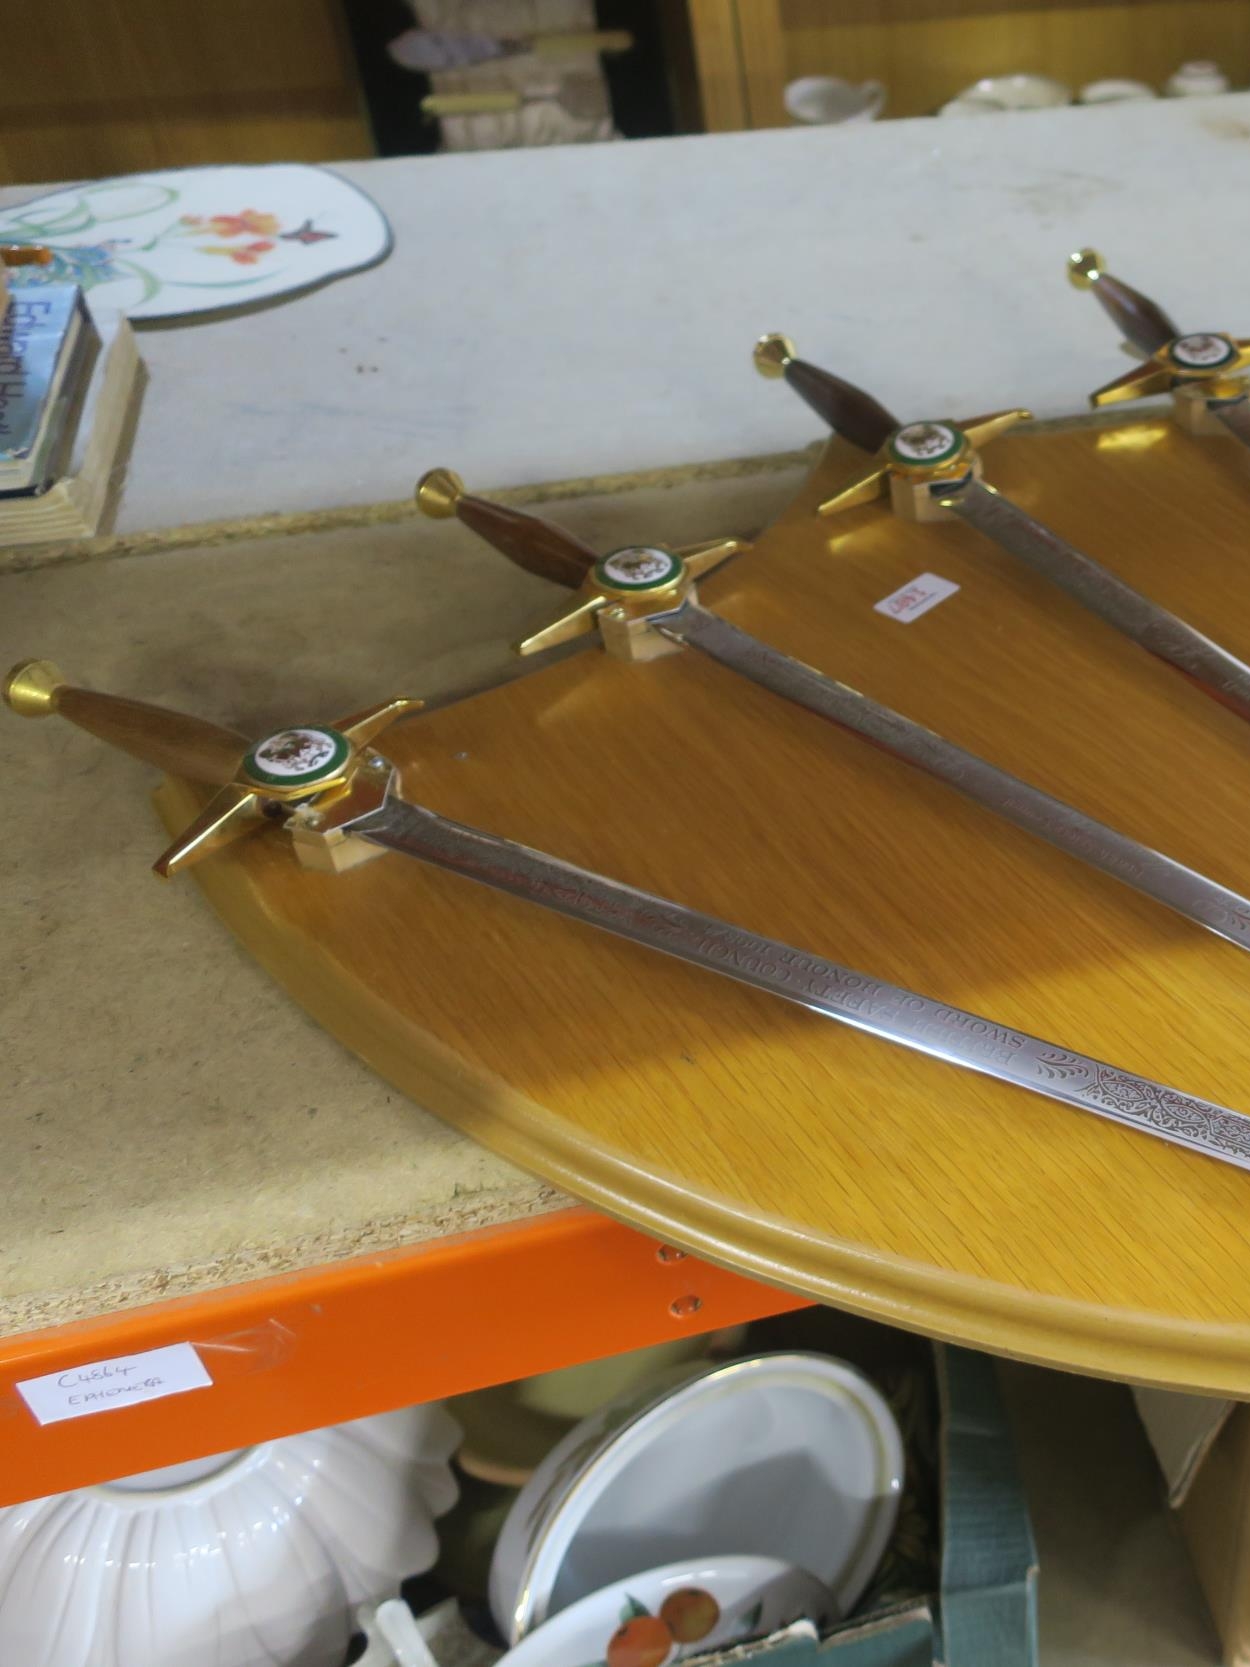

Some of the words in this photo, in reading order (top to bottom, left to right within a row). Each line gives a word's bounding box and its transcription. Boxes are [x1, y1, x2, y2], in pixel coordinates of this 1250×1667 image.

[779, 949, 882, 997] HONOUR
[903, 993, 925, 1013] OF
[934, 1008, 1028, 1049] SWORD
